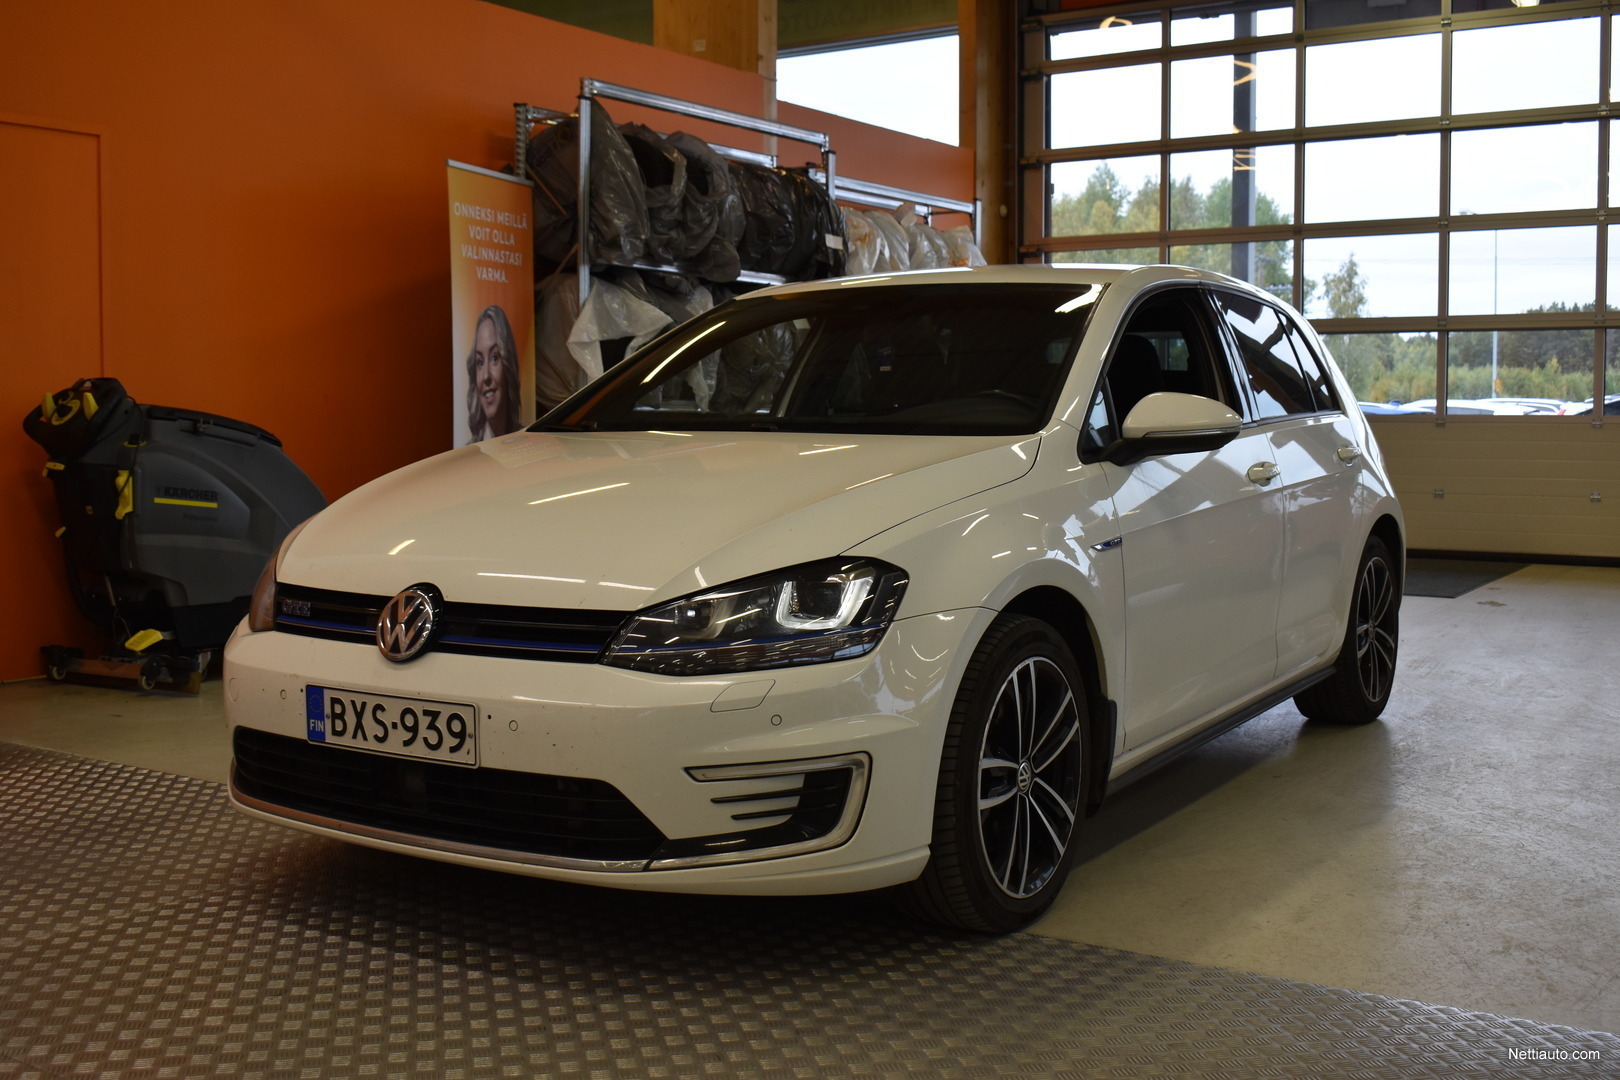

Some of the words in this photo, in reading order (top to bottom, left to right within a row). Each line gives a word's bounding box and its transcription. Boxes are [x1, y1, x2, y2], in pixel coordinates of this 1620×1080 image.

[453, 201, 495, 223] ONNEKSI
[497, 210, 528, 230] MEILLÄ
[468, 225, 491, 241] VOIT
[492, 229, 515, 247] OLLA
[461, 243, 523, 267] VALINNASTASI
[476, 266, 509, 284] VARMA.
[281, 599, 311, 617] GTE
[309, 719, 325, 733] FIN
[330, 697, 467, 753] BXS-939
